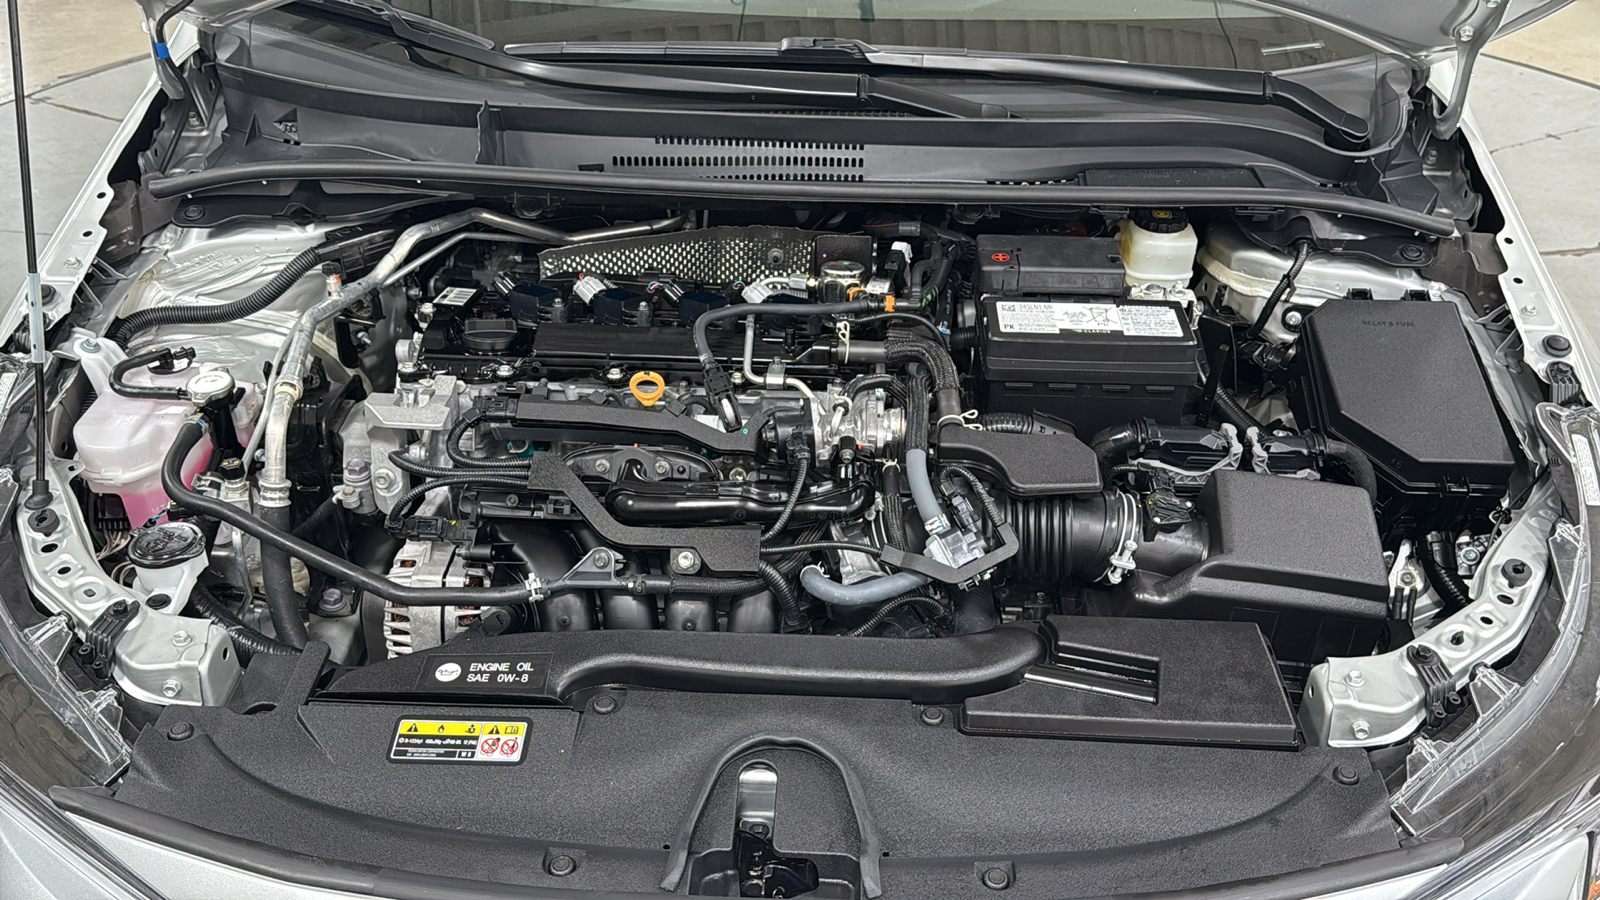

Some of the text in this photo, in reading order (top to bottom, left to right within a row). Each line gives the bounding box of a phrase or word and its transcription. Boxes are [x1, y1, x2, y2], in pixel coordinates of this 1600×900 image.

[469, 662, 534, 672] ENGINE OIL
[466, 673, 529, 683] SAE 0W-8
